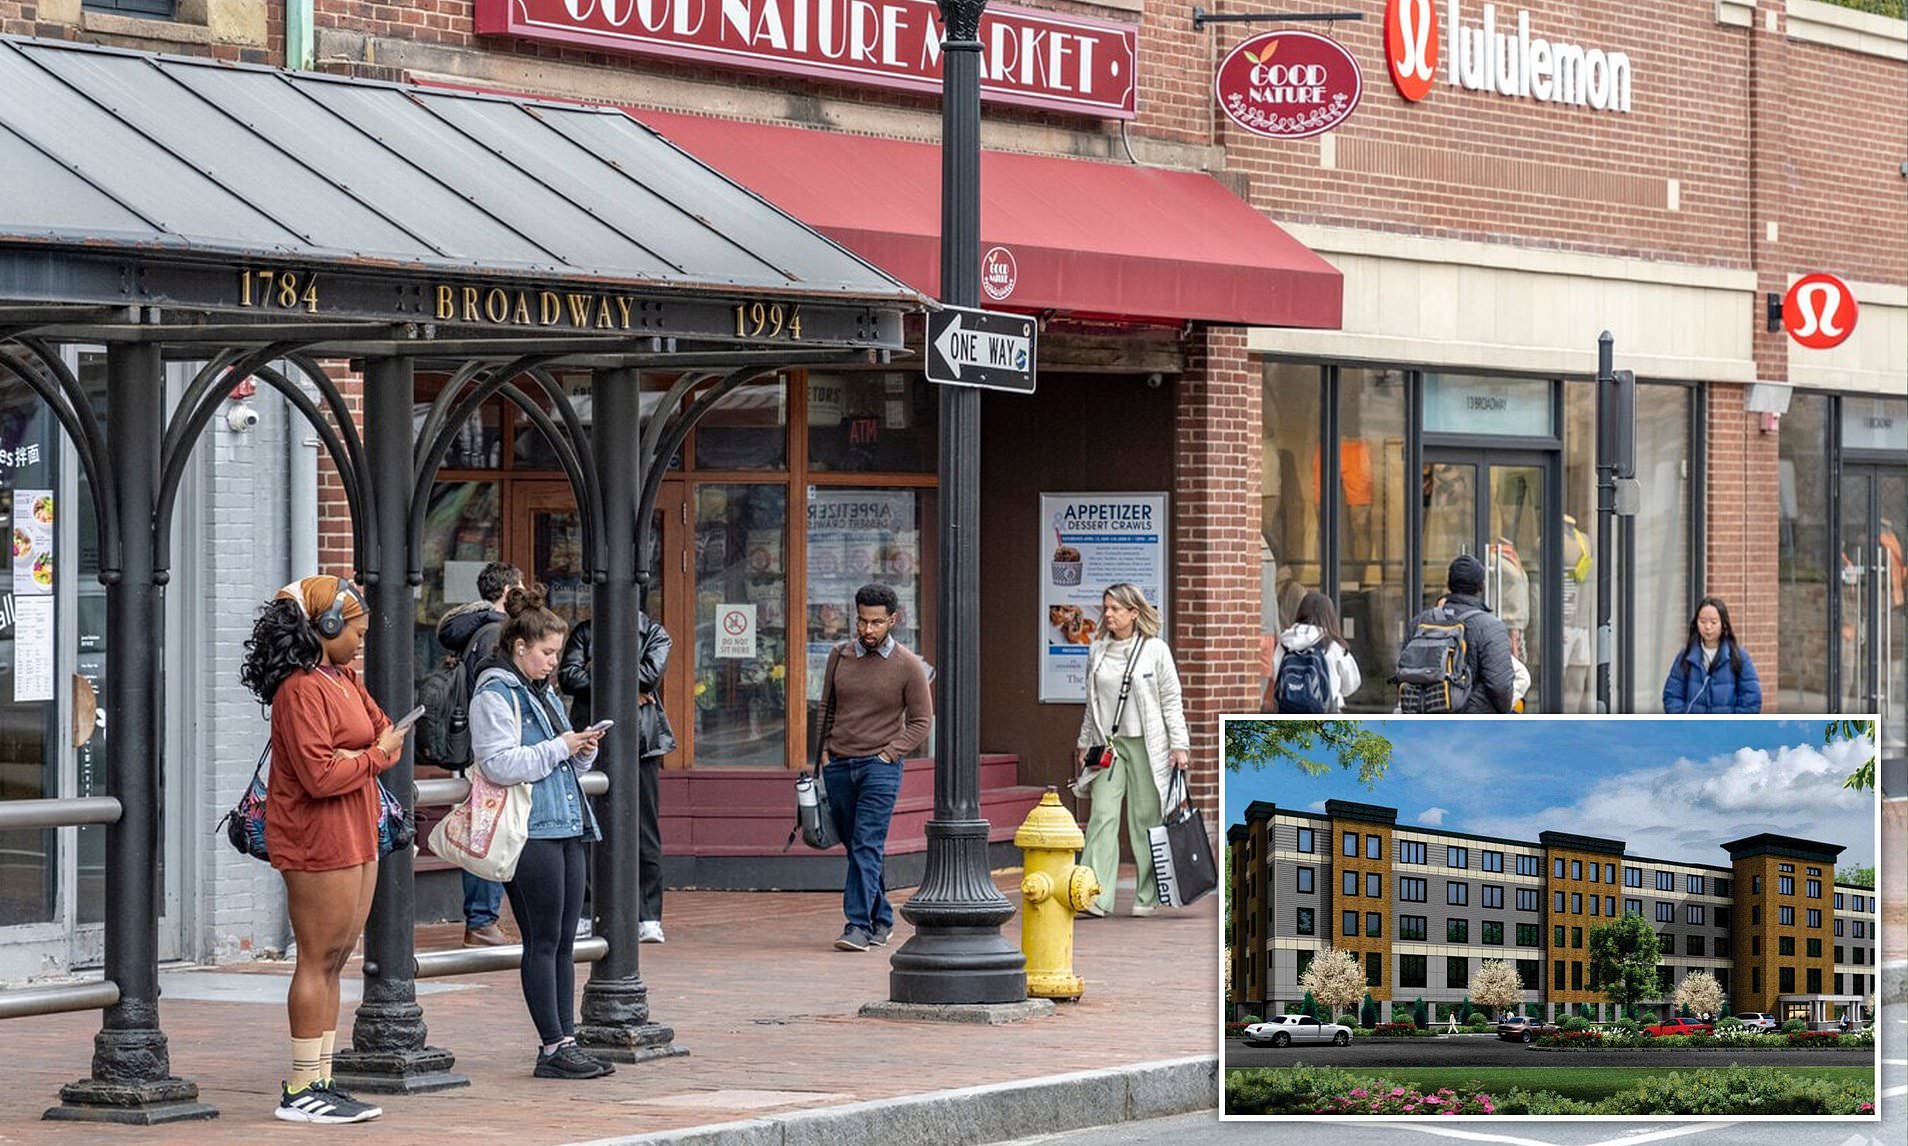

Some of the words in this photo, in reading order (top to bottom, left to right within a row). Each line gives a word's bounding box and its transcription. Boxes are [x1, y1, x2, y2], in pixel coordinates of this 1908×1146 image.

[720, 0, 908, 67] NATURE
[921, 12, 1098, 94] MRKET
[1447, 0, 1632, 113] lululemon
[1250, 64, 1327, 87] GOOD
[1249, 86, 1326, 104] NATURE
[239, 268, 319, 314] 1784
[435, 284, 634, 329] BROADWAY
[734, 301, 802, 340] 1994
[950, 332, 978, 362] ONE
[988, 336, 1015, 367] WAY
[849, 418, 879, 444] ATM
[1064, 504, 1153, 520] APPETIZER
[1068, 520, 1108, 530] DESSERT
[1111, 520, 1153, 530] CRAWLS
